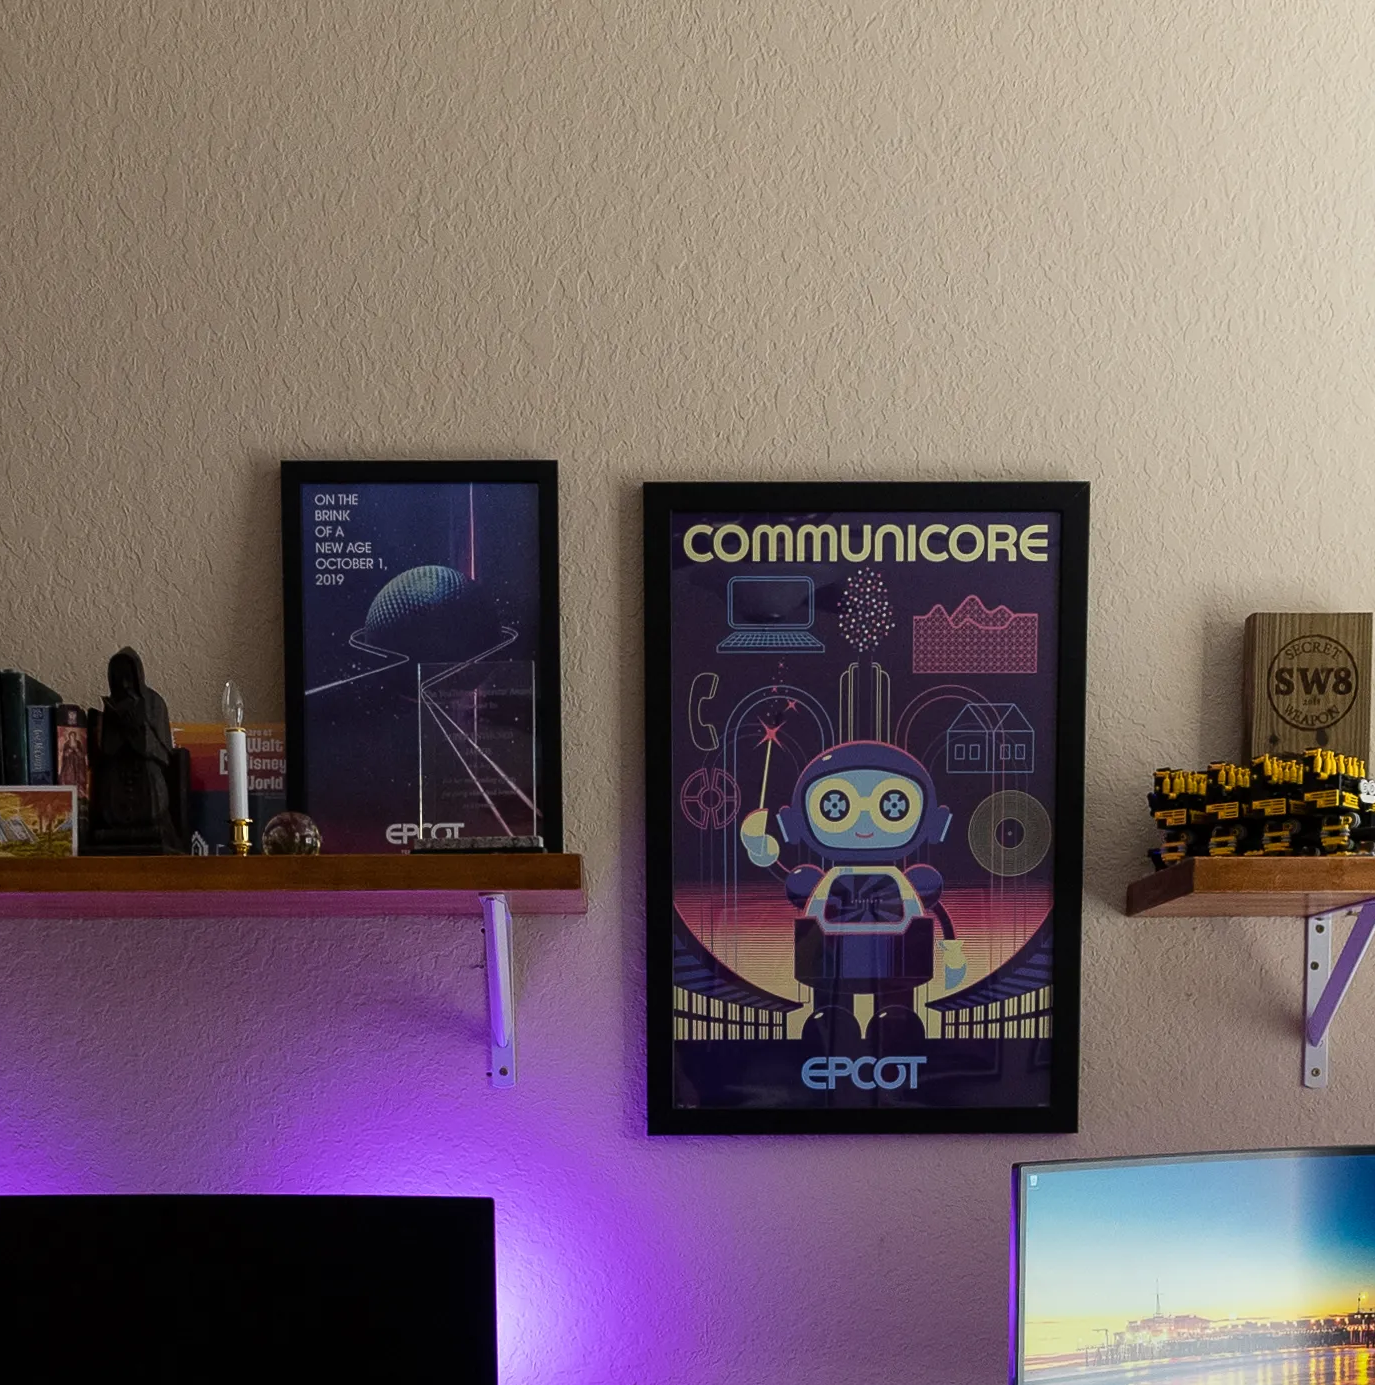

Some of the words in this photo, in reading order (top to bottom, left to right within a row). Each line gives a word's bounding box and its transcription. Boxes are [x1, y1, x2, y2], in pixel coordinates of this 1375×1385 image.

[314, 494, 335, 506] ON
[338, 493, 359, 506] THE
[314, 510, 351, 521] BRINK
[314, 526, 333, 538] OF
[335, 526, 345, 537] A
[315, 542, 344, 553] NEW
[346, 542, 372, 553] AGE
[682, 523, 1049, 563] COMMUNICORE
[315, 558, 374, 570] OCTOBER
[378, 558, 388, 572] 1,
[315, 574, 345, 586] 2019
[1285, 641, 1343, 661] SECRET
[1275, 666, 1353, 696] SW8
[1285, 704, 1341, 726] WEAPON
[246, 737, 284, 754] Walt
[248, 756, 287, 774] isney
[800, 1055, 928, 1091] EPCOT
